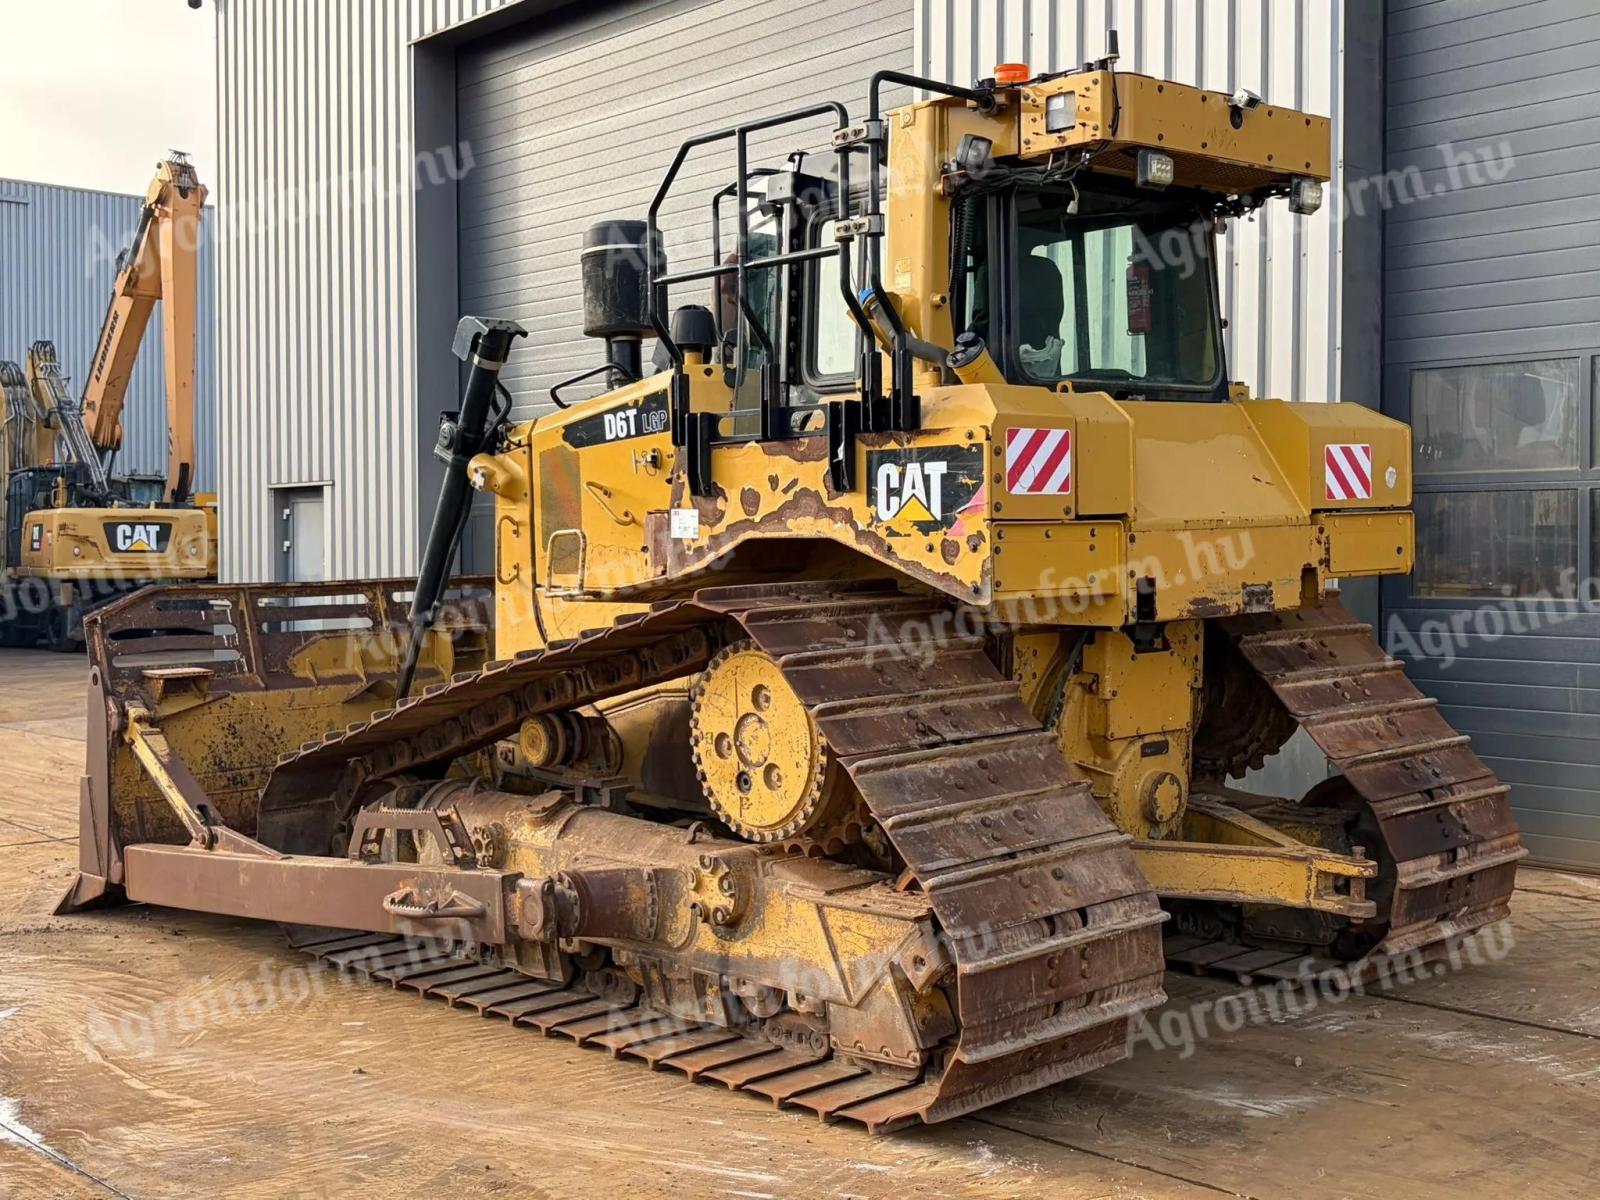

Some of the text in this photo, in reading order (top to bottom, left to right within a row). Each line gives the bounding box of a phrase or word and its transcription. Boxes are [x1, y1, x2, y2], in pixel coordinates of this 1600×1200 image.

[604, 408, 667, 440] D6T LGP
[877, 461, 947, 521] CAT
[116, 524, 160, 551] CAT
